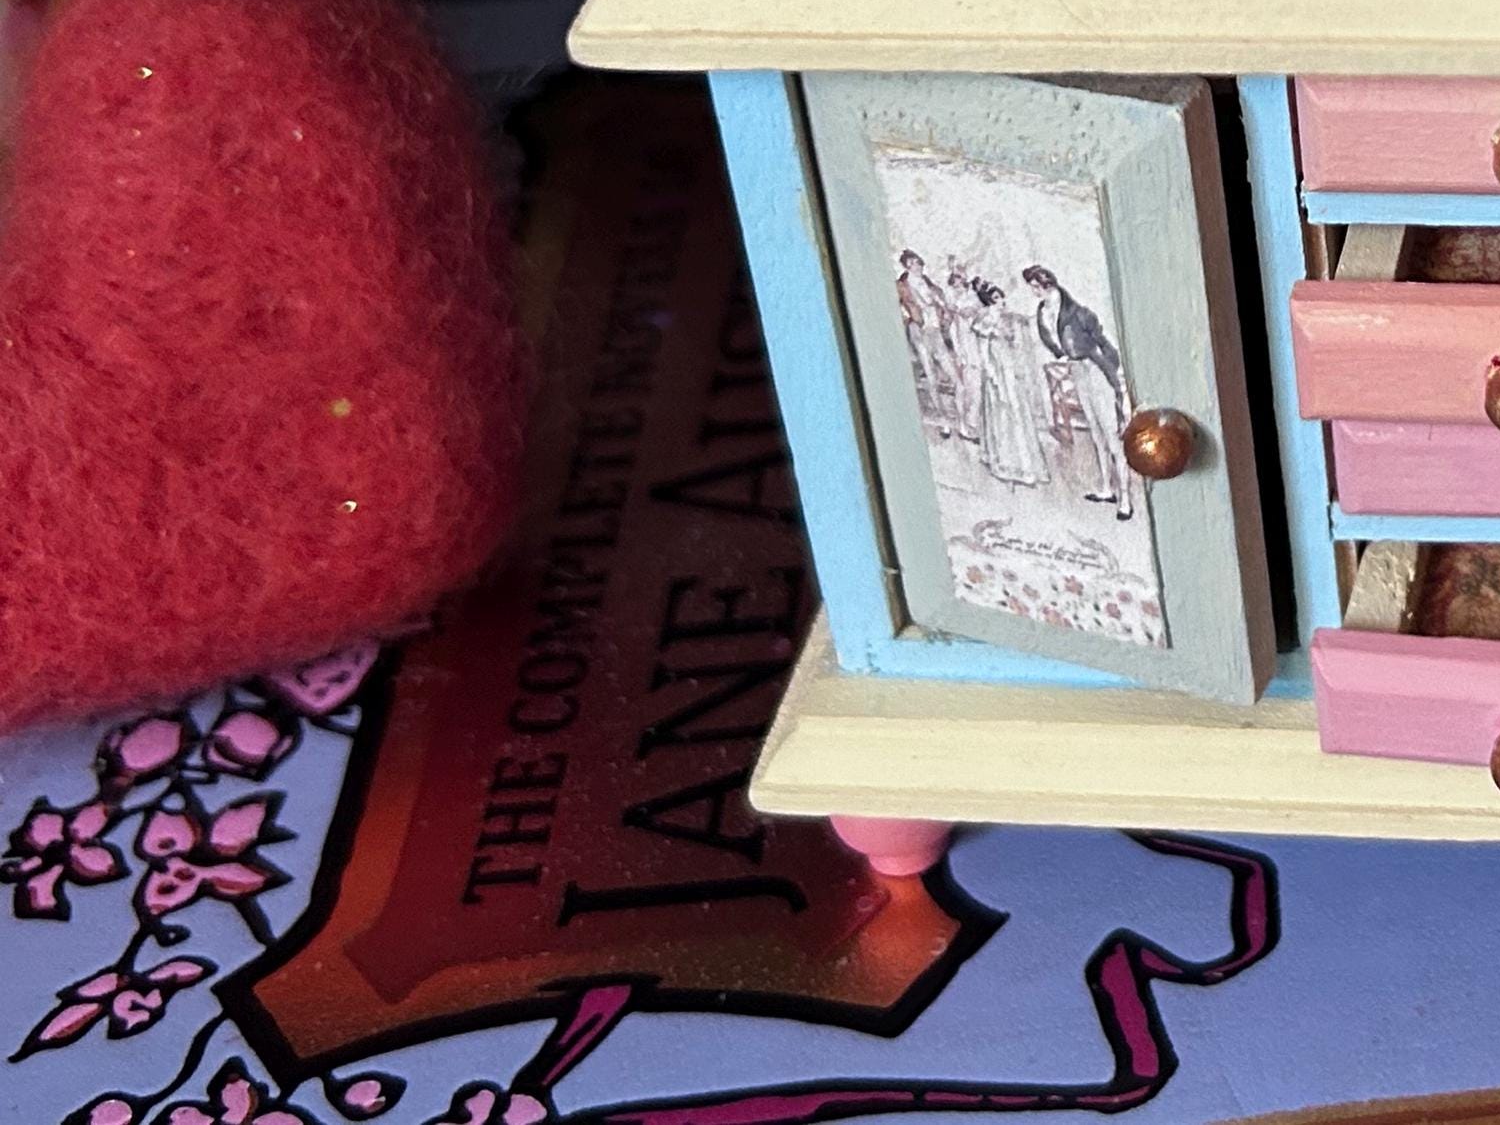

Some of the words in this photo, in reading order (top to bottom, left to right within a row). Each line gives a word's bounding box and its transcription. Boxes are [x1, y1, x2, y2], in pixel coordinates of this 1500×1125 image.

[507, 408, 644, 736] COMPLETE
[462, 751, 569, 905] THE
[556, 565, 808, 927] JANE
